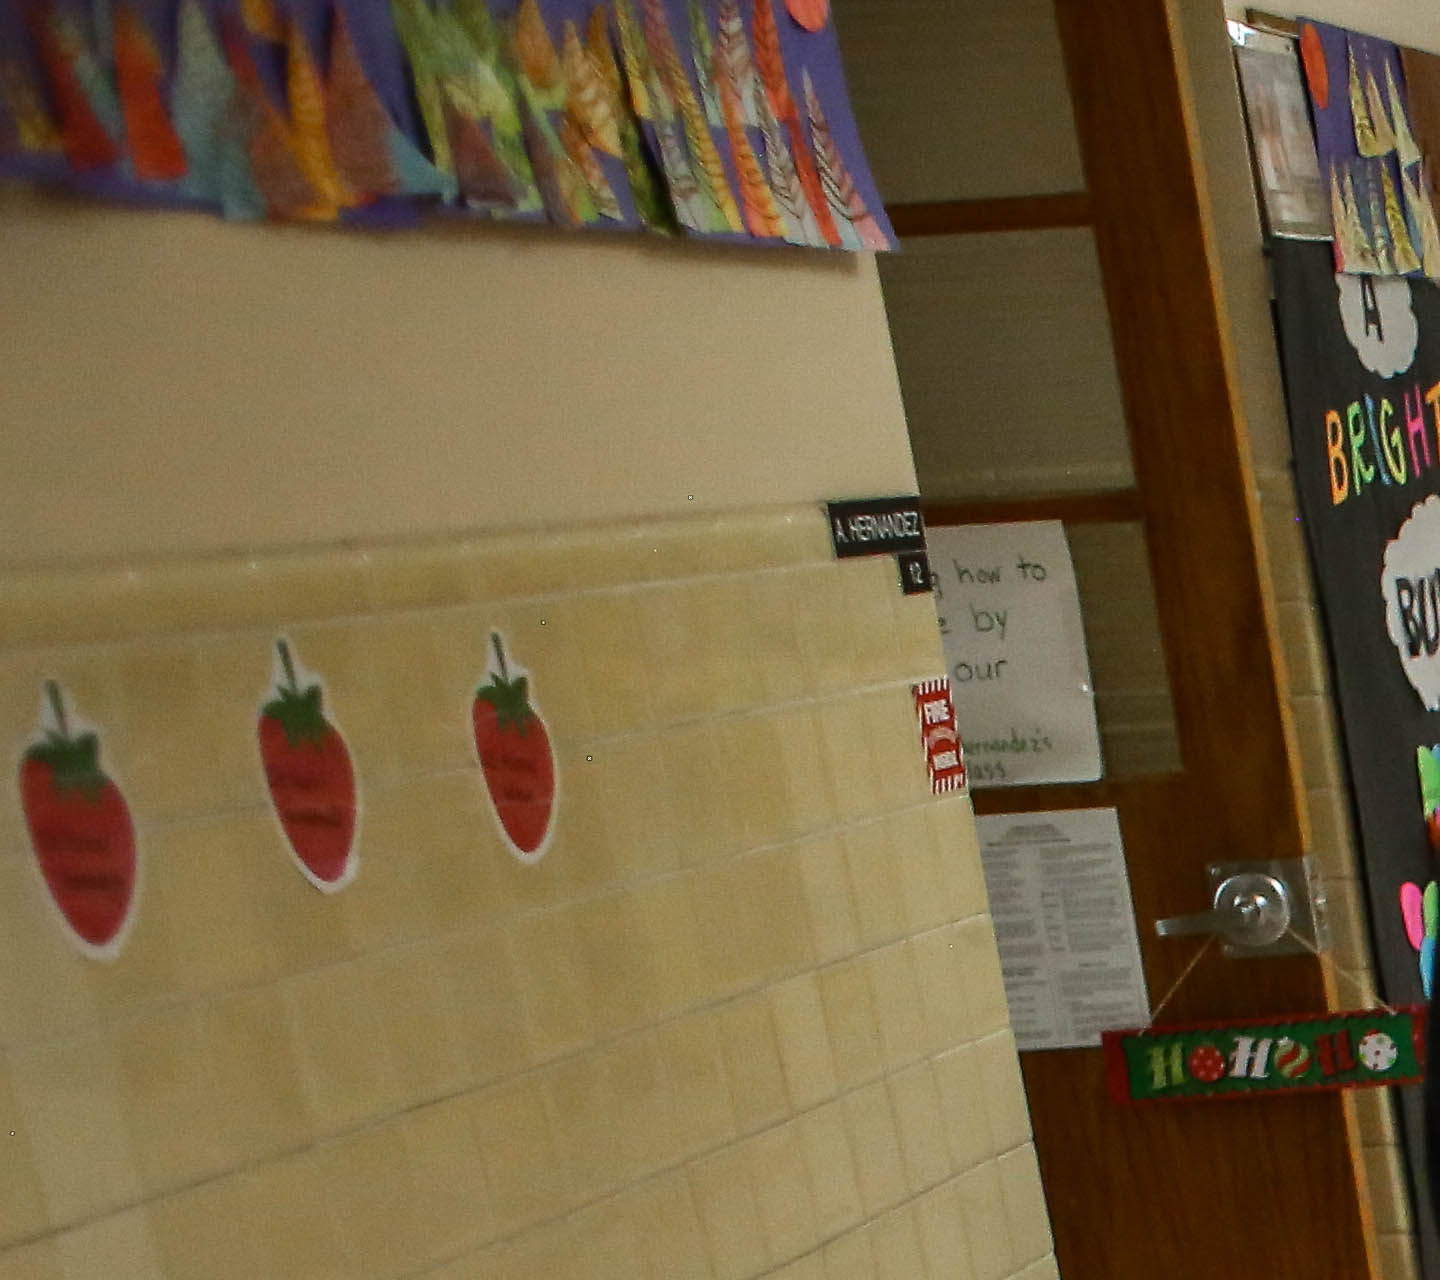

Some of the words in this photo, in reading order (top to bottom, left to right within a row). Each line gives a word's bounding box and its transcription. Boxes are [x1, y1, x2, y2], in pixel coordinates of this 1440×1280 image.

[1361, 274, 1385, 344] A
[953, 558, 1001, 584] how
[1016, 554, 1047, 581] to
[970, 603, 1008, 640] by
[955, 660, 1009, 683] our
